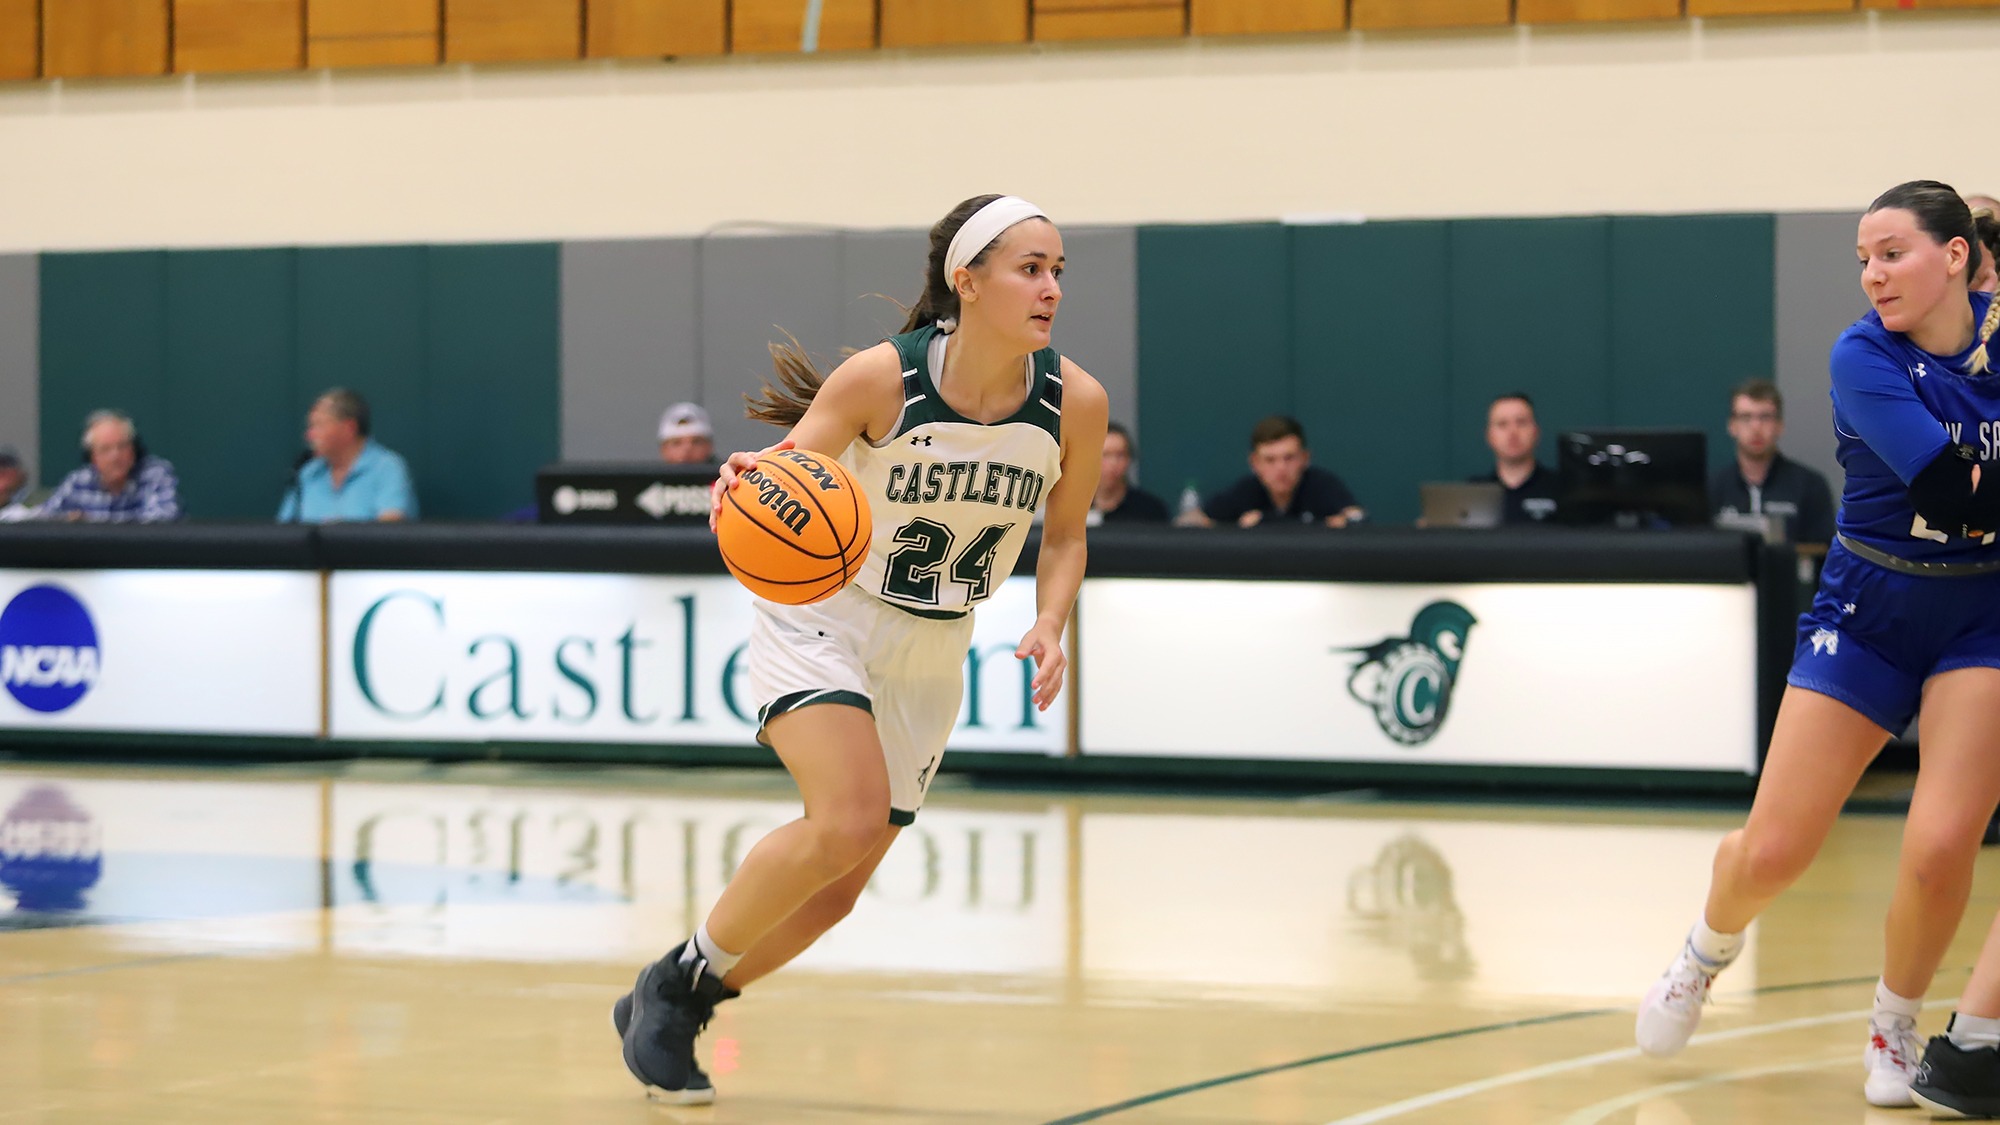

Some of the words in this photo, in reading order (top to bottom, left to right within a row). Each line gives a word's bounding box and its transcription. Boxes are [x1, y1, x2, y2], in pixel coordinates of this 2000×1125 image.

[741, 468, 812, 537] Wilson
[777, 450, 840, 491] NCAA
[881, 516, 1016, 606] 24
[2, 644, 100, 688] NCAA
[352, 589, 1042, 727] Castlen
